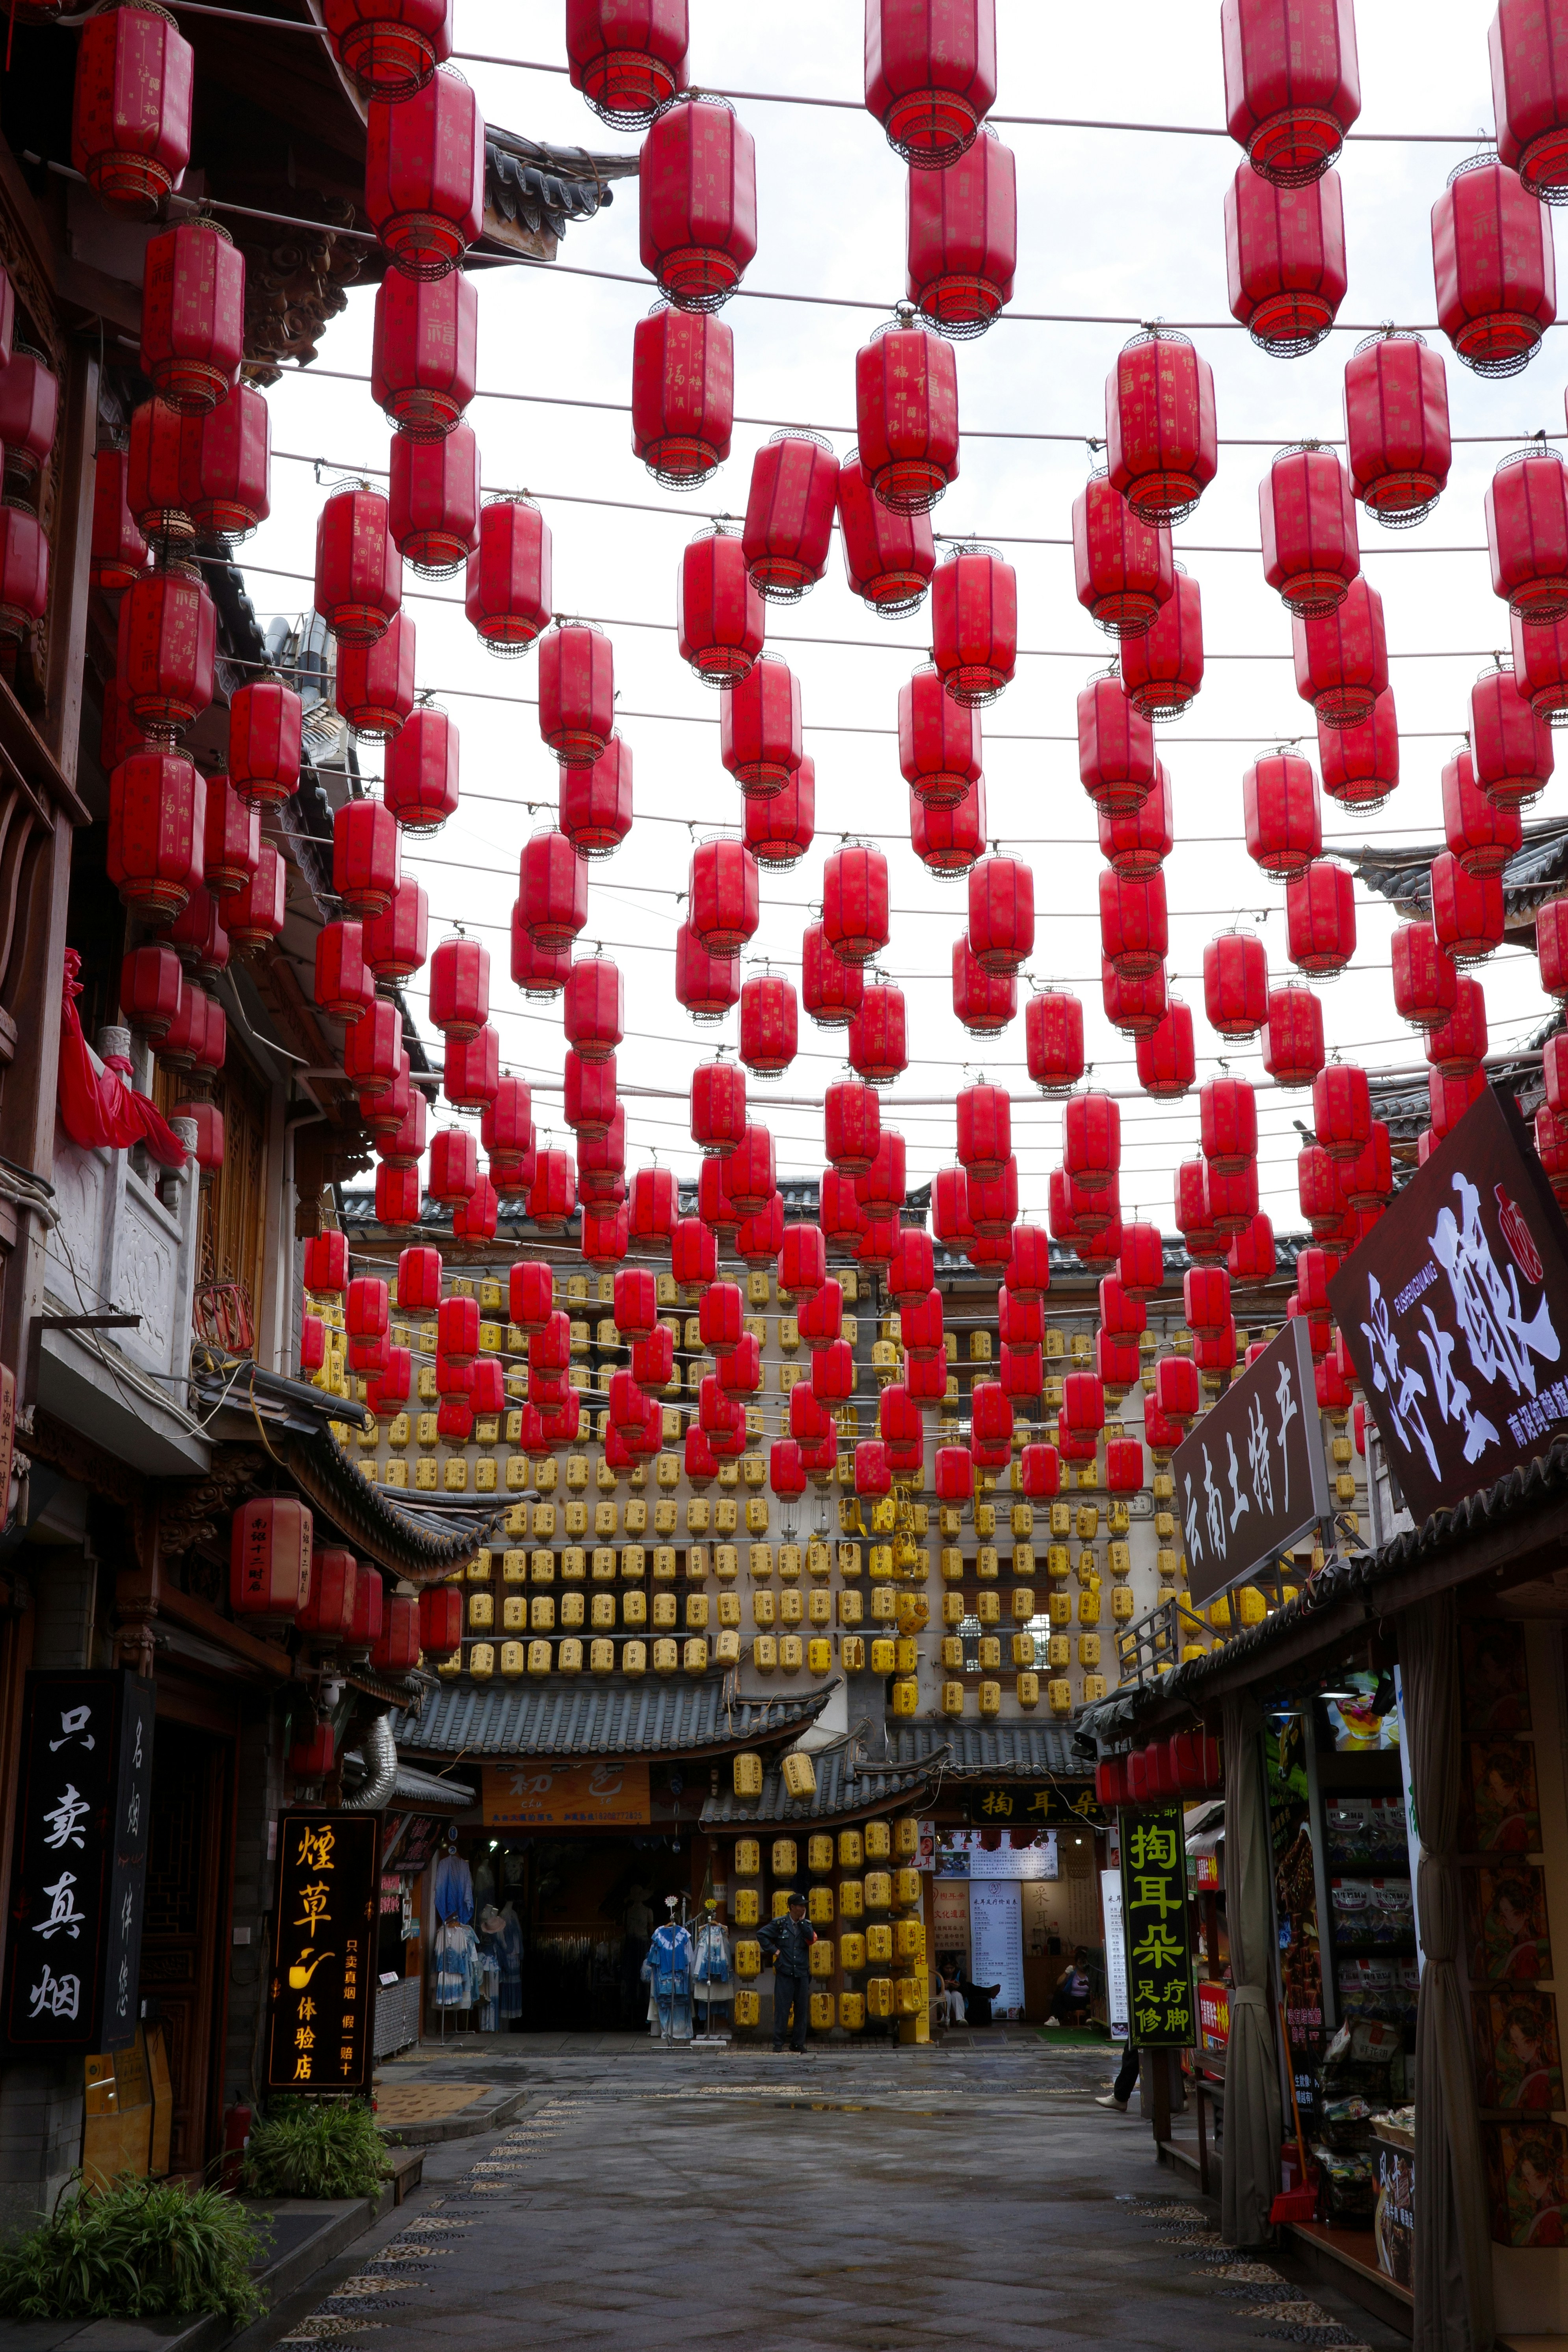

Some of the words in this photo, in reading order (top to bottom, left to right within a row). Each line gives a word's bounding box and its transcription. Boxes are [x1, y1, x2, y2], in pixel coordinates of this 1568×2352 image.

[428, 318, 455, 346] 福
[666, 364, 684, 385] 福
[893, 366, 908, 377] 福
[1161, 370, 1174, 381] 福
[914, 367, 939, 398] 福
[1166, 419, 1175, 427] 福
[487, 1330, 493, 1344] 吉市
[1048, 1338, 1054, 1352] 吉市
[883, 1348, 889, 1363] 吉市
[333, 1363, 339, 1381] 吉市
[422, 1422, 427, 1436] 吉市
[671, 1423, 677, 1438] 吉市
[661, 1461, 668, 1477] 吉市
[1185, 1361, 1298, 1566] 云南土特产
[478, 1467, 484, 1482] 吉市
[516, 1465, 523, 1480] 吉市
[575, 1510, 581, 1526] 吉市
[752, 1507, 758, 1522] 吉市
[1080, 1517, 1086, 1531] 吉市
[567, 1556, 573, 1571] 吉市
[603, 1556, 609, 1571] 吉市
[660, 1555, 667, 1570] 吉市
[719, 1553, 725, 1569] 吉市
[811, 1551, 817, 1566] 吉市
[876, 1553, 883, 1568] 吉市
[1018, 1552, 1025, 1566] 吉市
[1114, 1551, 1121, 1565] 吉市
[476, 1603, 482, 1619] 吉市
[723, 1601, 729, 1617] 吉市
[764, 1600, 771, 1616] 吉市
[816, 1598, 823, 1614] 吉市
[844, 1600, 851, 1614] 吉市
[884, 1597, 890, 1612] 吉市
[1017, 1597, 1023, 1611] 吉市
[1059, 1602, 1066, 1618] 吉市
[1115, 1596, 1122, 1611] 吉市
[513, 1606, 519, 1621] 吉市
[603, 1604, 610, 1619] 吉市
[534, 1647, 541, 1663] 吉市
[565, 1647, 571, 1661] 吉市
[762, 1644, 769, 1658] 吉市
[788, 1644, 794, 1659] 吉市
[1052, 1644, 1058, 1658] 吉市
[1086, 1642, 1092, 1657] 吉市
[948, 1691, 955, 1705] 吉市
[985, 1690, 991, 1705] 吉市
[1024, 1682, 1030, 1699] 吉市
[521, 1800, 543, 1808] chu
[982, 1790, 1100, 1818] 掏耳朵
[903, 1829, 910, 1844] 吉市
[923, 1824, 932, 1834] 采
[851, 1841, 858, 1857] 吉市
[867, 1833, 874, 1850] 吉市
[28, 1705, 95, 2020] 只卖真烟
[752, 1850, 757, 1867] 吉市
[924, 1857, 931, 1868] 耳
[294, 1825, 335, 1937] 煙草
[911, 1878, 917, 1895] 吉市
[870, 1883, 877, 1899] 吉市
[1130, 1825, 1184, 1969] 掏耳朵
[1032, 1886, 1050, 1926] 采耳
[850, 1943, 858, 1961] 吉市
[877, 1936, 884, 1953] 吉市
[738, 1951, 744, 1968] 吉市
[344, 1939, 358, 2000] 只卖真烟
[1135, 1979, 1187, 2003] 足疗
[742, 2001, 748, 2018] 吉市
[843, 2005, 849, 2021] 吉市
[1287, 2008, 1321, 2025] 没有结过婚
[1135, 2006, 1189, 2033] 修脚
[293, 1997, 317, 2080] 体验店
[340, 2015, 355, 2076] 假一赔十
